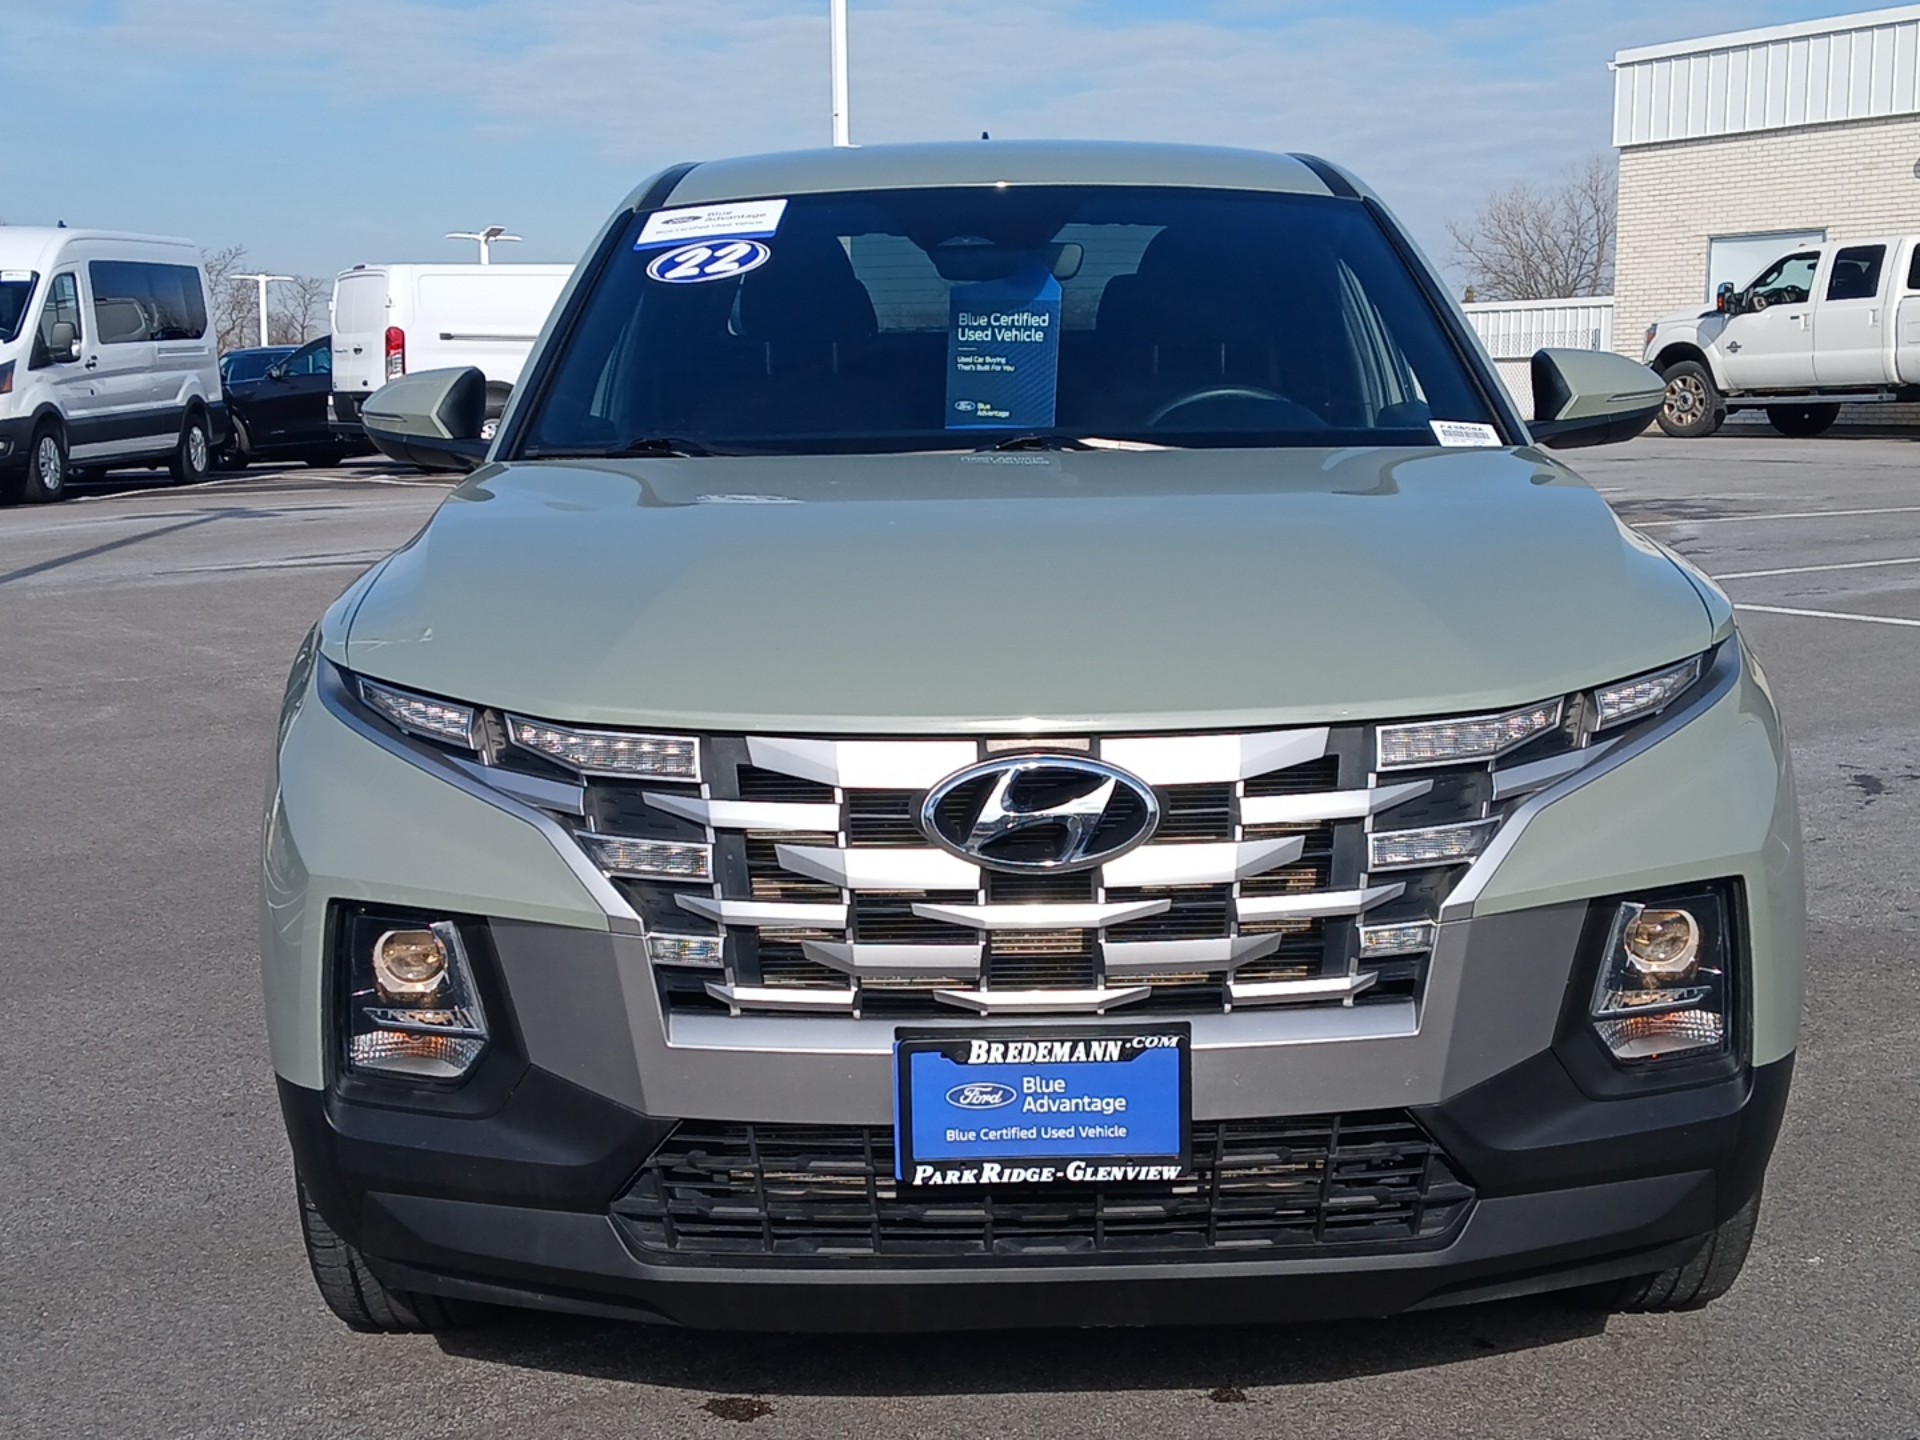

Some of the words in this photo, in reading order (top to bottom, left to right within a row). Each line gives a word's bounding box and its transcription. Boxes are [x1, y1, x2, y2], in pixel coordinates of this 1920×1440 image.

[663, 242, 753, 280] 22
[958, 312, 988, 327] Blue
[990, 312, 1050, 327] Certified
[957, 327, 992, 341] Used
[994, 327, 1045, 342] Vehicle
[1022, 1076, 1066, 1093] Blue
[959, 1086, 1003, 1106] Ford
[1022, 1095, 1127, 1115] Advantage
[946, 1129, 976, 1142] Blue
[980, 1127, 1037, 1141] Certified
[1040, 1126, 1075, 1139] Used
[1079, 1125, 1128, 1139] Vehicle
[913, 1163, 979, 1186] PARK
